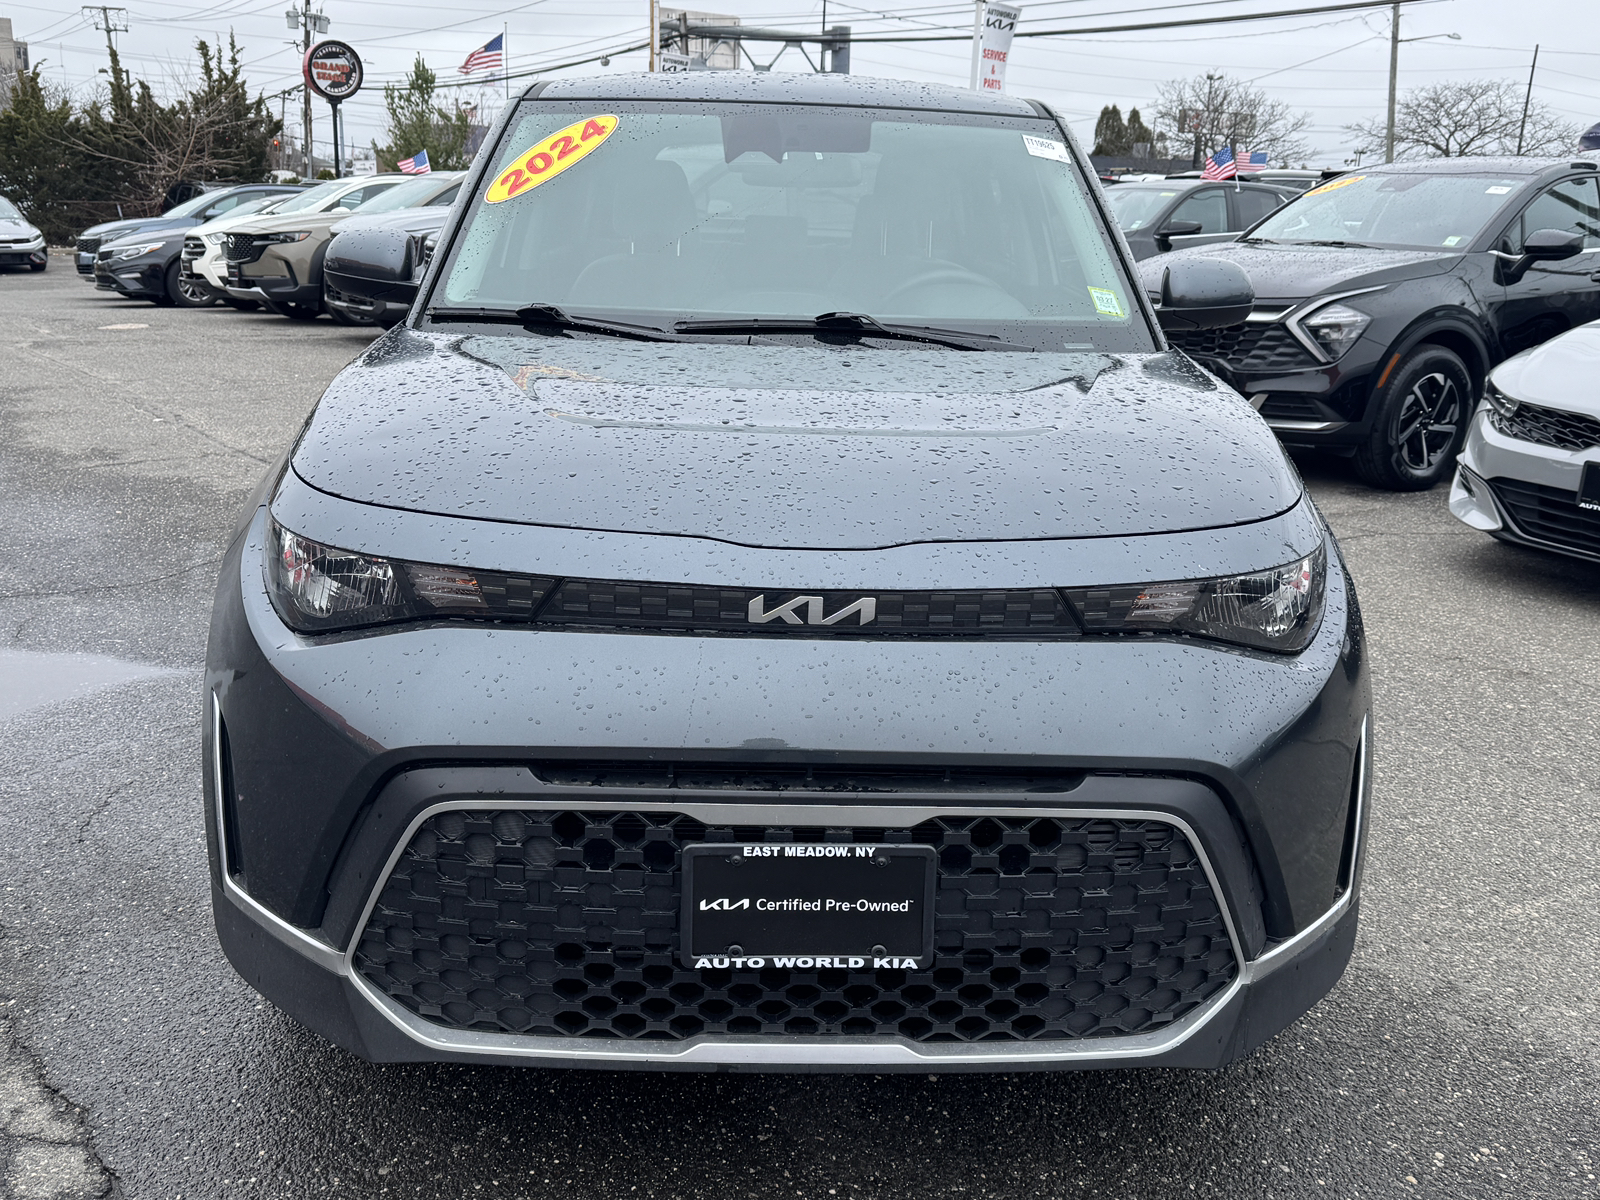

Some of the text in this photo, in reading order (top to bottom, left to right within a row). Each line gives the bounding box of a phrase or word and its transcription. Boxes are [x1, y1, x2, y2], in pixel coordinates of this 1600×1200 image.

[987, 7, 1017, 20] AUTOWORLD
[986, 17, 1015, 32] KIA
[982, 48, 1007, 62] SERVICE
[312, 61, 351, 73] GRAND
[662, 57, 689, 67] AUTOWORLD
[991, 64, 996, 75] &
[983, 78, 1002, 90] PARTS
[501, 119, 608, 196] 2024
[748, 594, 876, 626] KIA
[743, 846, 780, 858] EAST
[855, 846, 876, 858] NY
[699, 898, 749, 911] KIA
[756, 898, 821, 911] Certified
[694, 957, 918, 969] AUTO WORLD KIA
